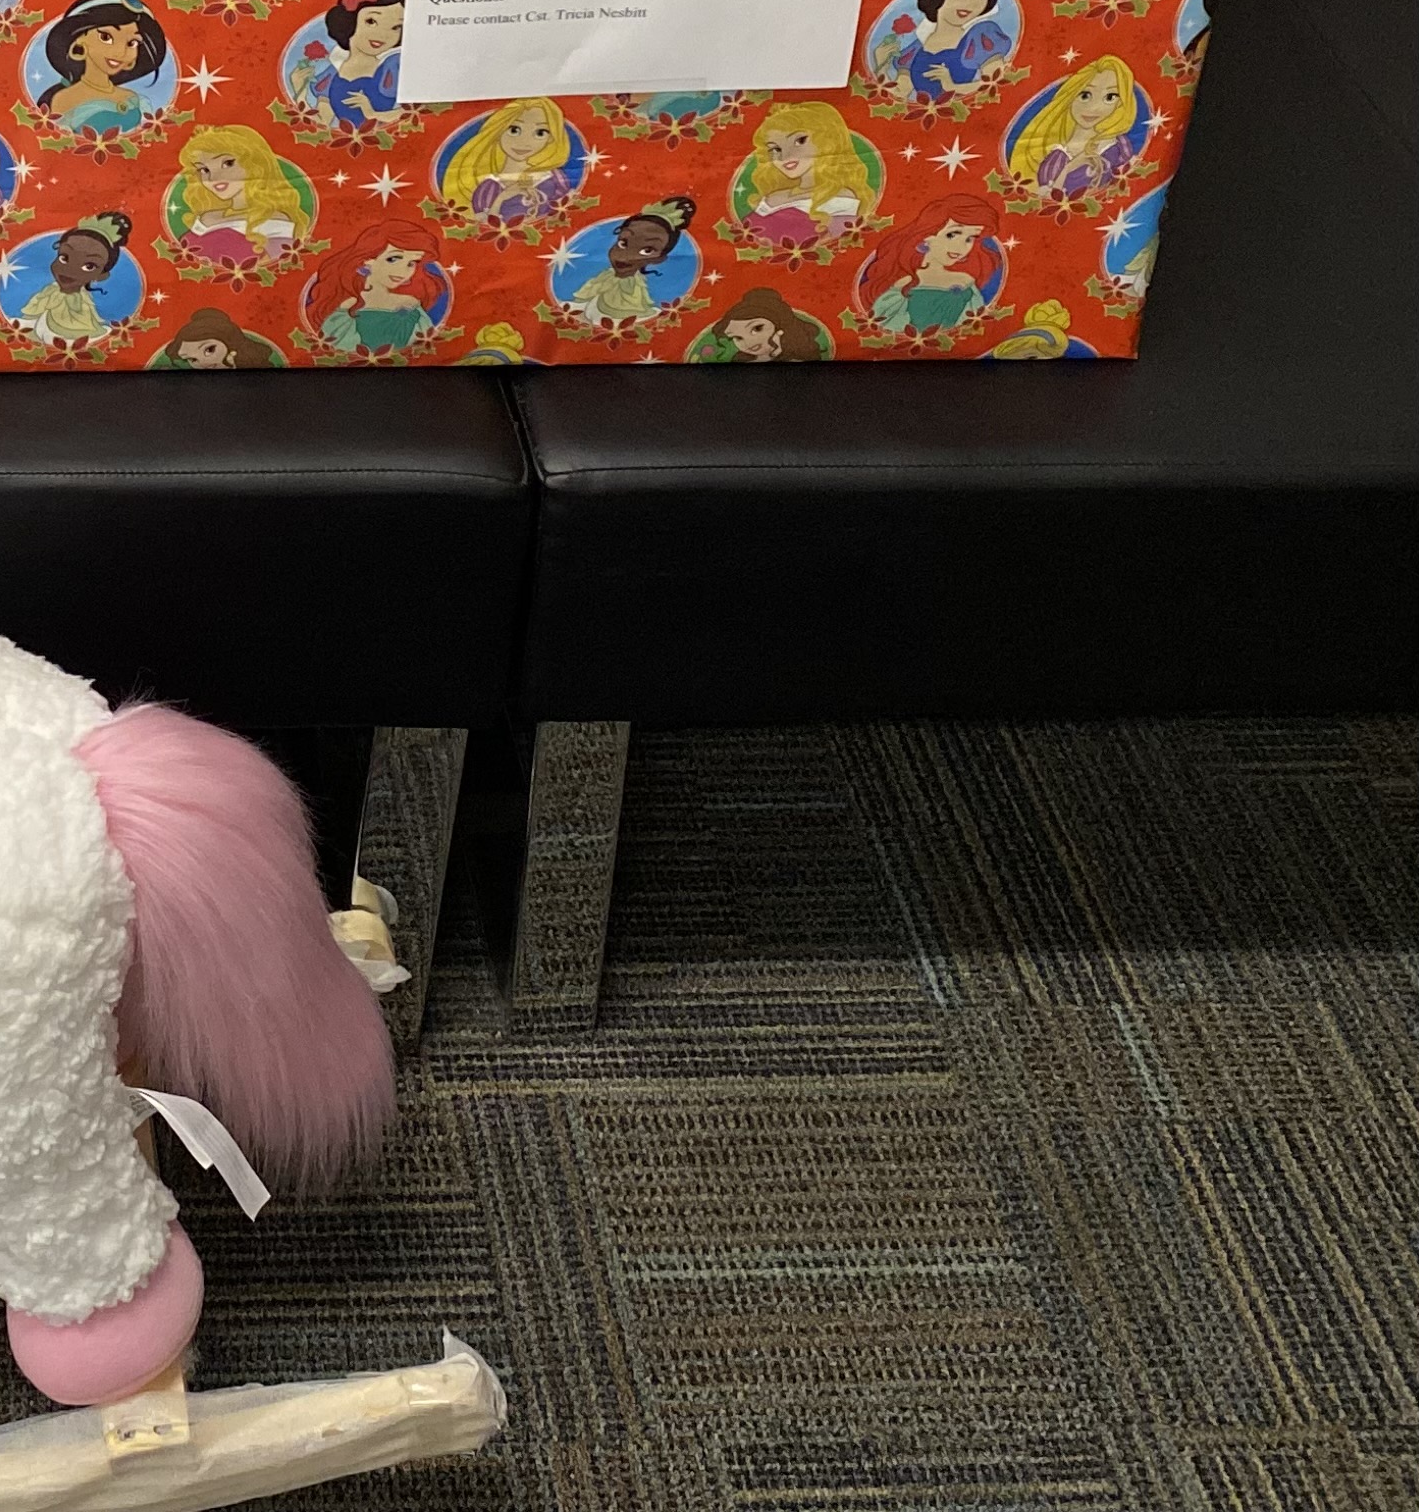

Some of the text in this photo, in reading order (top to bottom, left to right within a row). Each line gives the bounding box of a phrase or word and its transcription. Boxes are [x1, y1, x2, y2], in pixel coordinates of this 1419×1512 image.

[427, 7, 647, 26] Please contact Cst. Tricia Nesbitt
